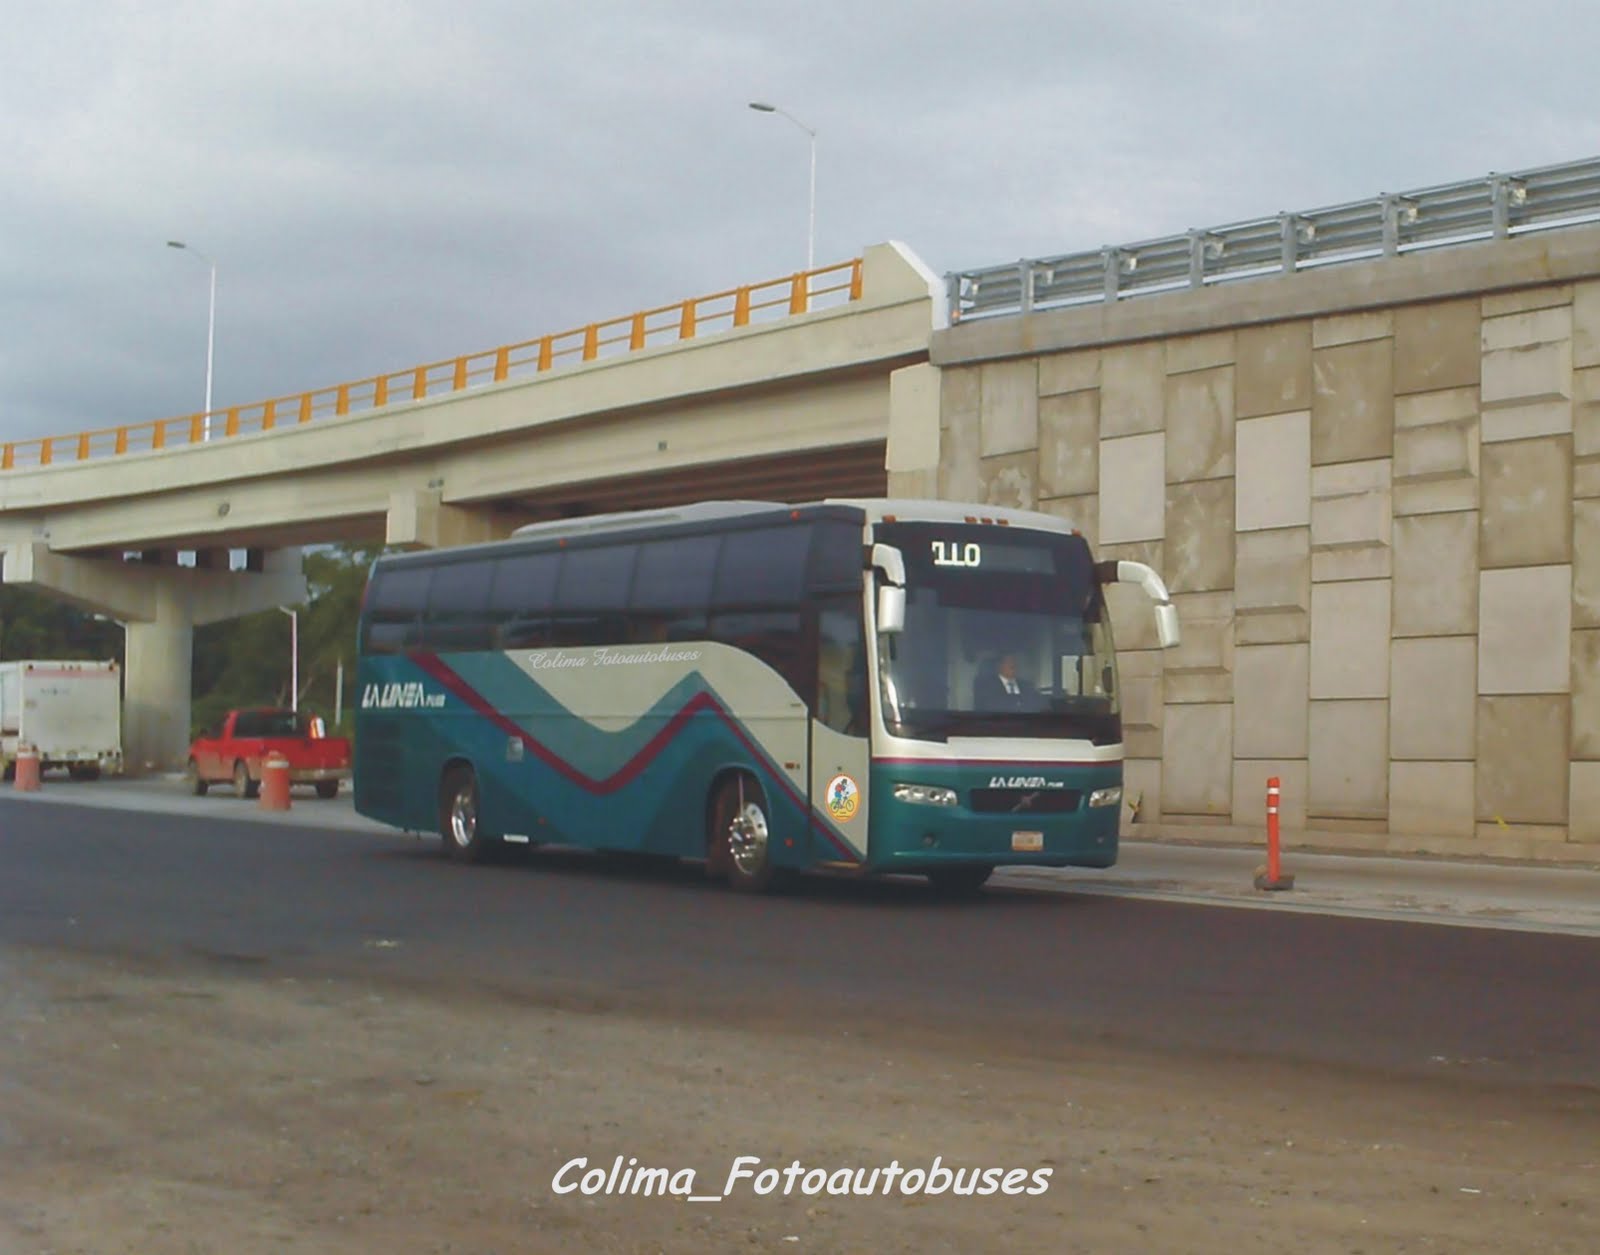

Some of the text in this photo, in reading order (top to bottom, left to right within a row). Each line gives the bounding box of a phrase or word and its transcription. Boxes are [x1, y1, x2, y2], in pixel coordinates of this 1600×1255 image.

[361, 683, 380, 708] LA
[380, 682, 425, 708] LINEA
[989, 776, 1006, 788] LA
